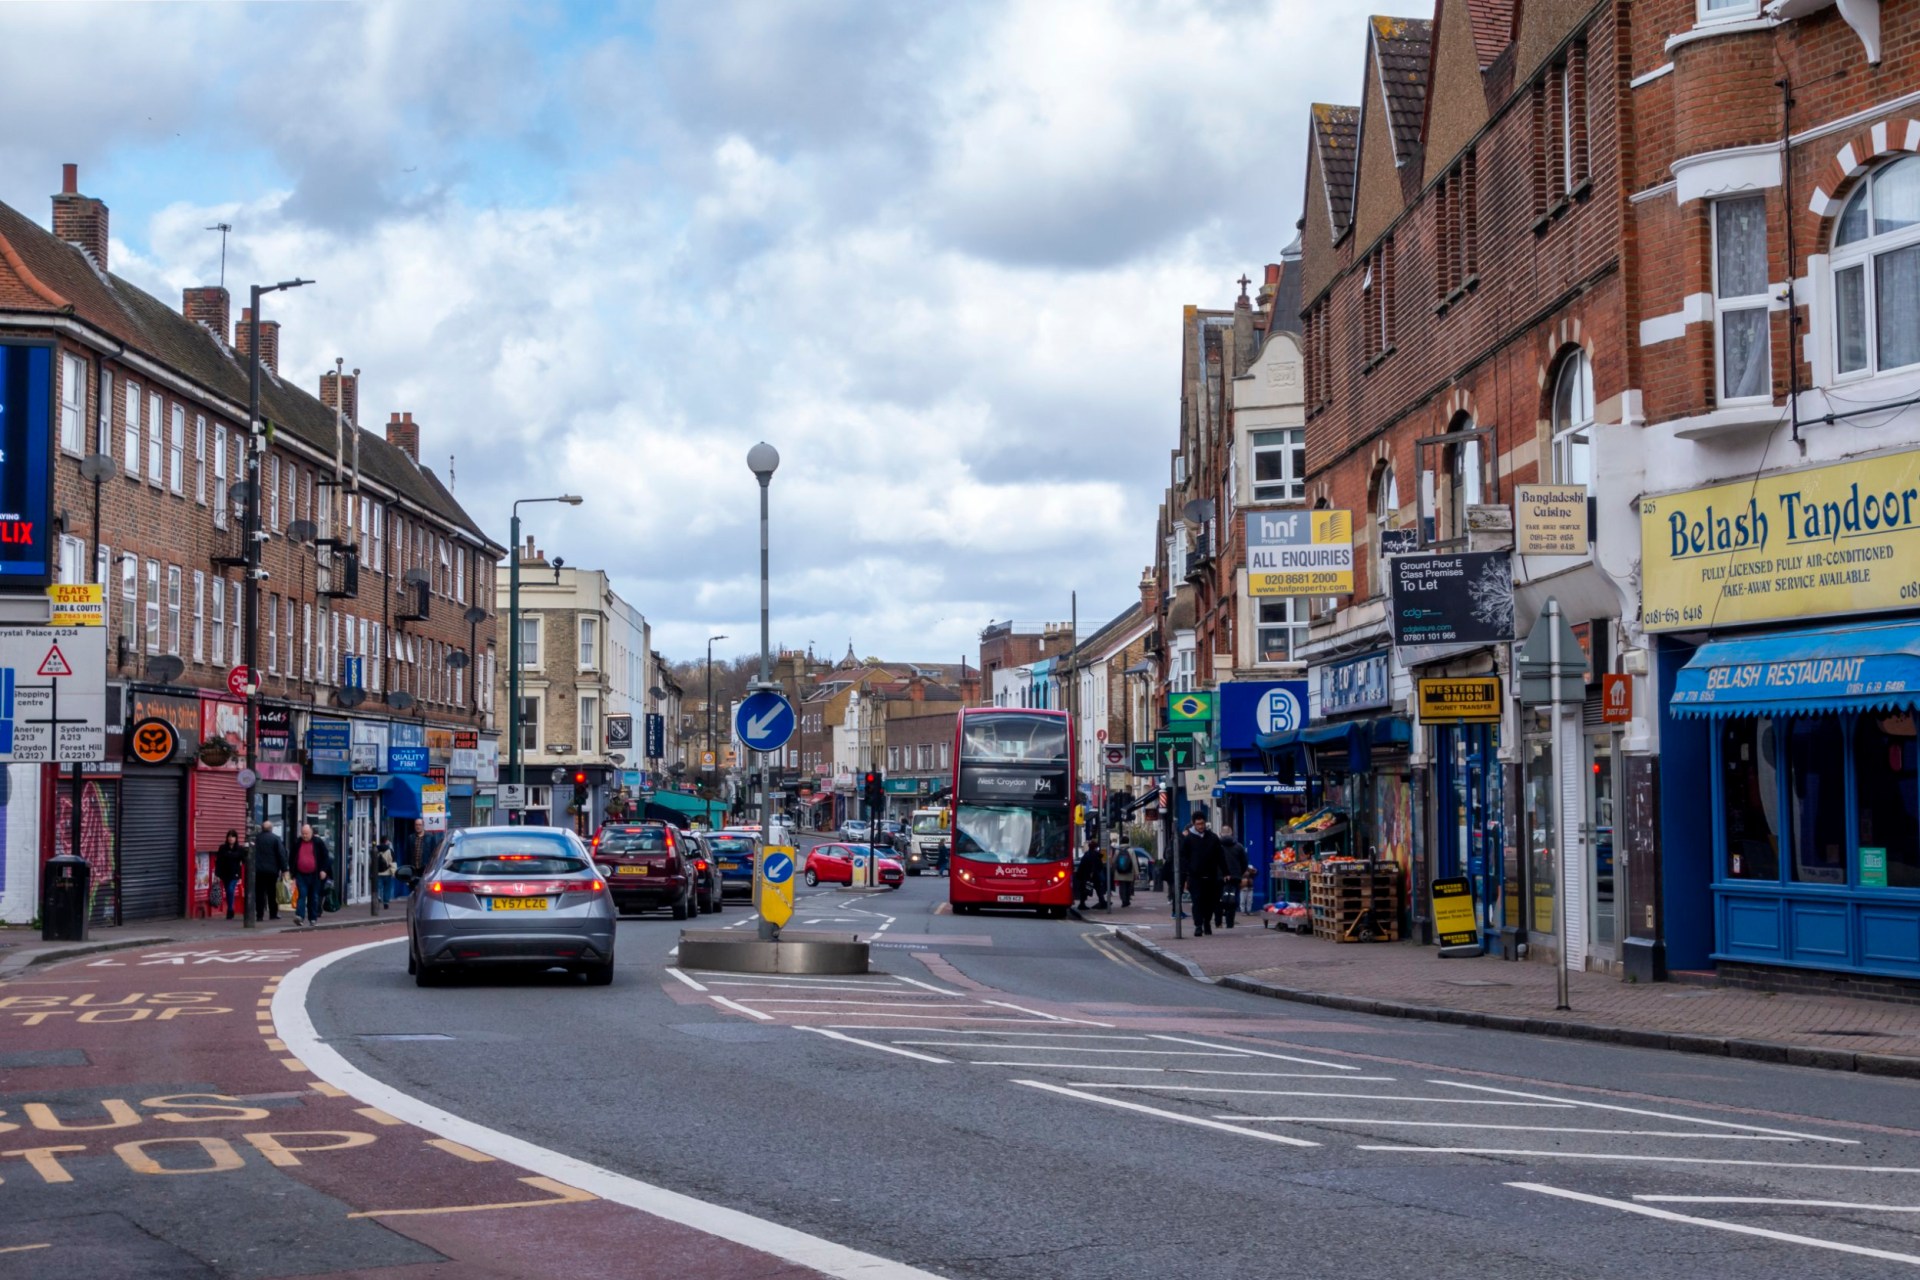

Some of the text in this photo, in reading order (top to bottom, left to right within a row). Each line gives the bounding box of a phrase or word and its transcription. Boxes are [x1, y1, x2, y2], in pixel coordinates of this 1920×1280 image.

[1522, 491, 1584, 505] Bangladeshi
[1533, 506, 1572, 518] Cuisine
[1668, 482, 1920, 556] Belash Tandoor
[1261, 514, 1298, 538] hnf
[1253, 549, 1350, 568] ALL ENQUIRIES
[1702, 545, 1893, 582] FULLY LICENSED FULLY AIR-CONDITIONED
[1400, 559, 1462, 570] Ground Floor E
[1265, 573, 1337, 585] 020 8681 2000
[1400, 569, 1464, 579] Class Premises
[1401, 579, 1438, 591] To Let
[1722, 569, 1870, 597] TAKE-AWAY SERVICE AVAILABLE
[1256, 584, 1347, 594] www.hnfproperty.com
[76, 604, 101, 612] COUTTS
[0, 630, 23, 638] rystal
[1707, 658, 1865, 689] BELASH RESTAURANT
[14, 690, 50, 699] Shopping
[1425, 685, 1483, 694] WESTERN
[1444, 693, 1483, 701] UNION
[1607, 708, 1630, 716] JUST EAT
[14, 726, 44, 734] Anerley
[60, 726, 102, 734] Sydenham
[14, 744, 47, 752] Croydon
[60, 752, 96, 760] (A2216)
[392, 754, 425, 762] QUALITY
[997, 778, 1027, 786] Croydon
[1035, 779, 1051, 791] 194
[1005, 866, 1028, 874] arriva
[494, 898, 546, 908] LY57 CZC
[86, 955, 300, 966] LANE
[0, 992, 218, 1008] BUS
[12, 1006, 234, 1026] TOP
[0, 1131, 378, 1184] TOP
